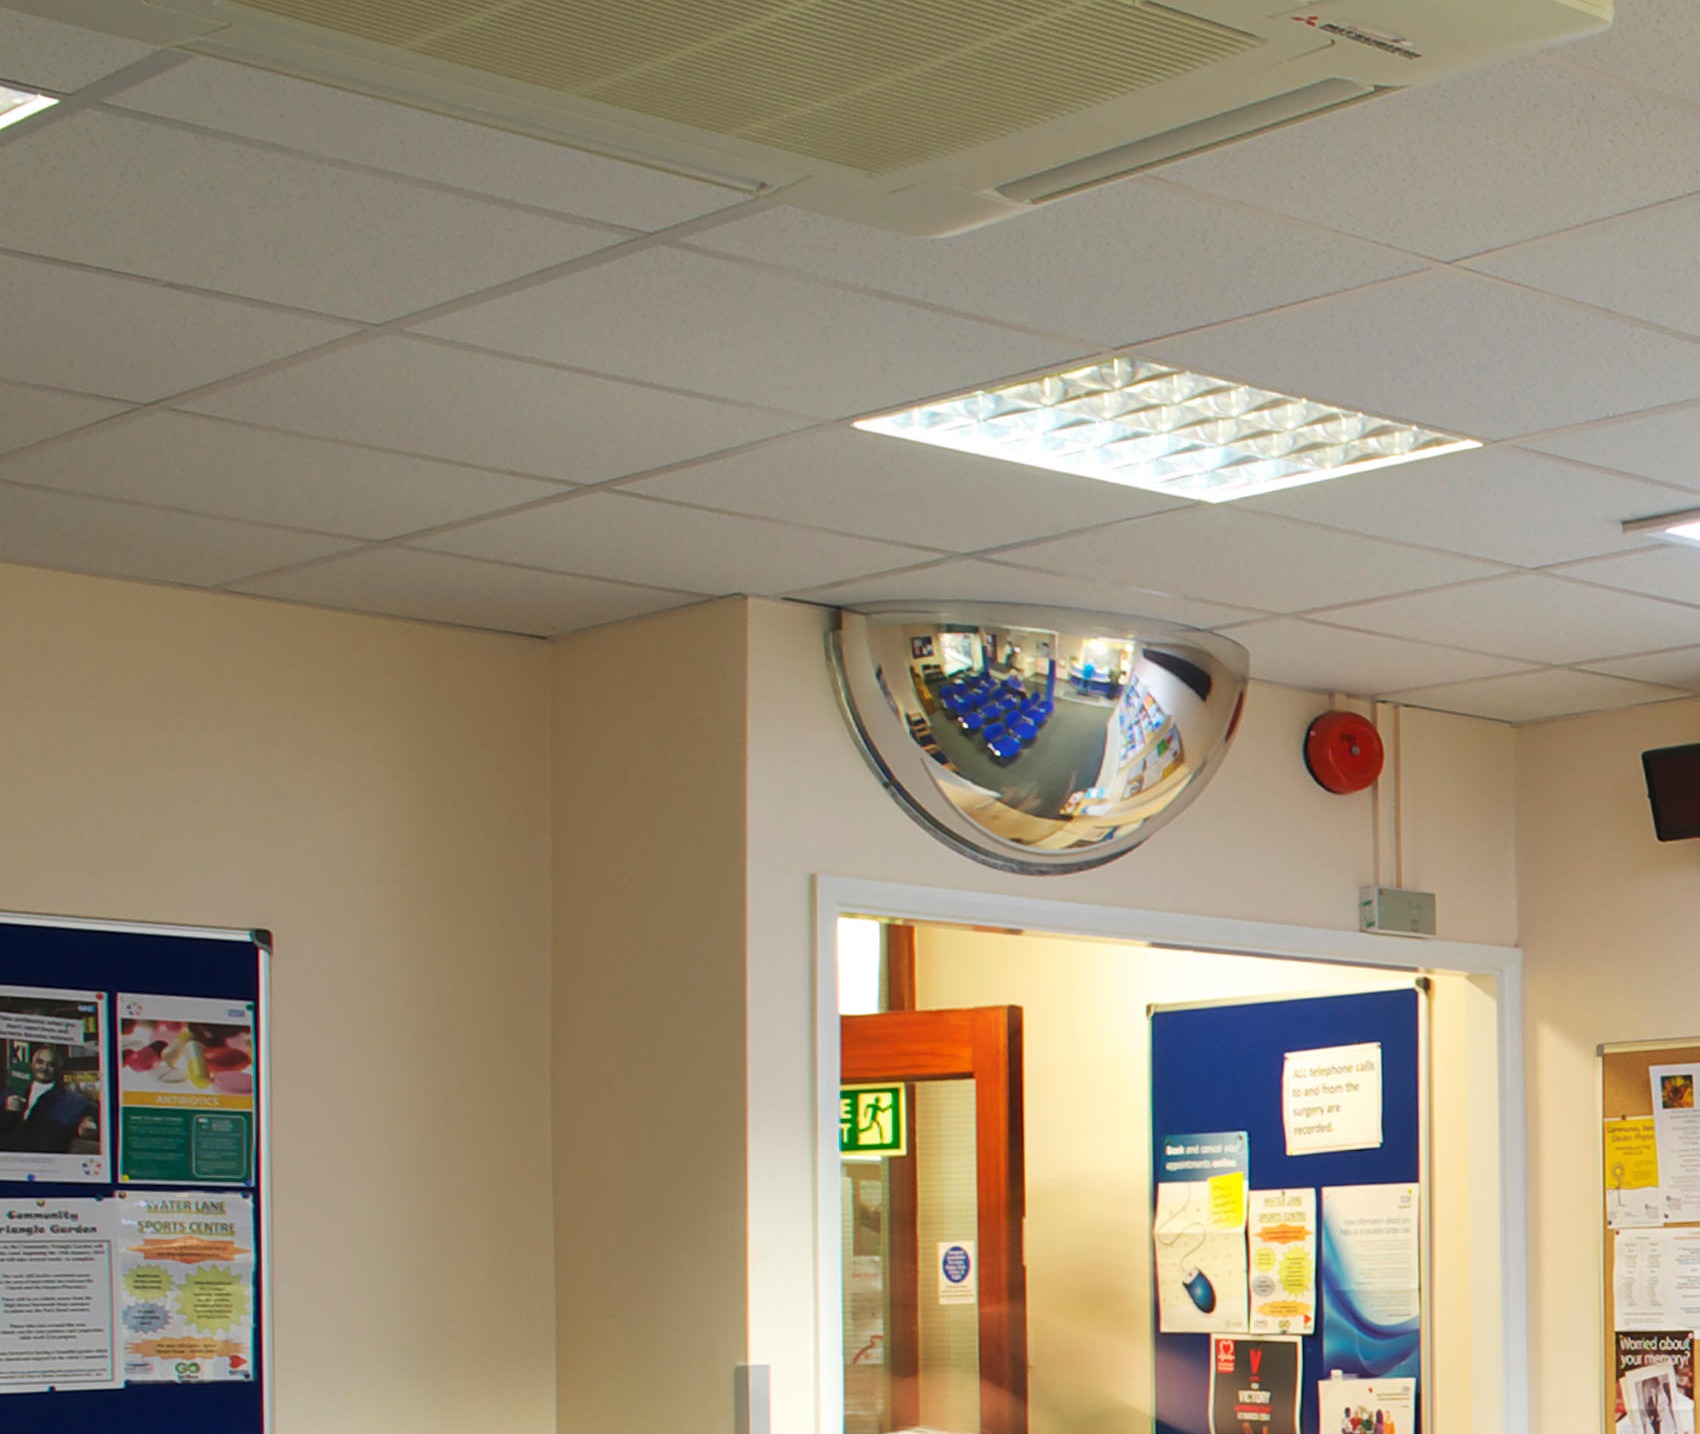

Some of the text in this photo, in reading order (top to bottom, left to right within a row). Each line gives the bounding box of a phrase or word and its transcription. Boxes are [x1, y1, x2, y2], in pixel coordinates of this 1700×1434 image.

[1309, 1064, 1353, 1077] telephone
[1356, 1060, 1375, 1072] calls
[1304, 1086, 1319, 1097] and
[1322, 1084, 1344, 1095] from
[1345, 1080, 1359, 1092] the
[155, 1095, 219, 1106] ANTIBIOTICS
[1293, 1104, 1341, 1118] surgery are
[145, 1200, 226, 1213] WATER LANE
[6, 1211, 79, 1222] Community
[0, 1224, 97, 1236] riangle Garden
[137, 1220, 236, 1234] SPORTS CENTRE
[1620, 1336, 1691, 1350] Worried about
[1620, 1354, 1643, 1369] your
